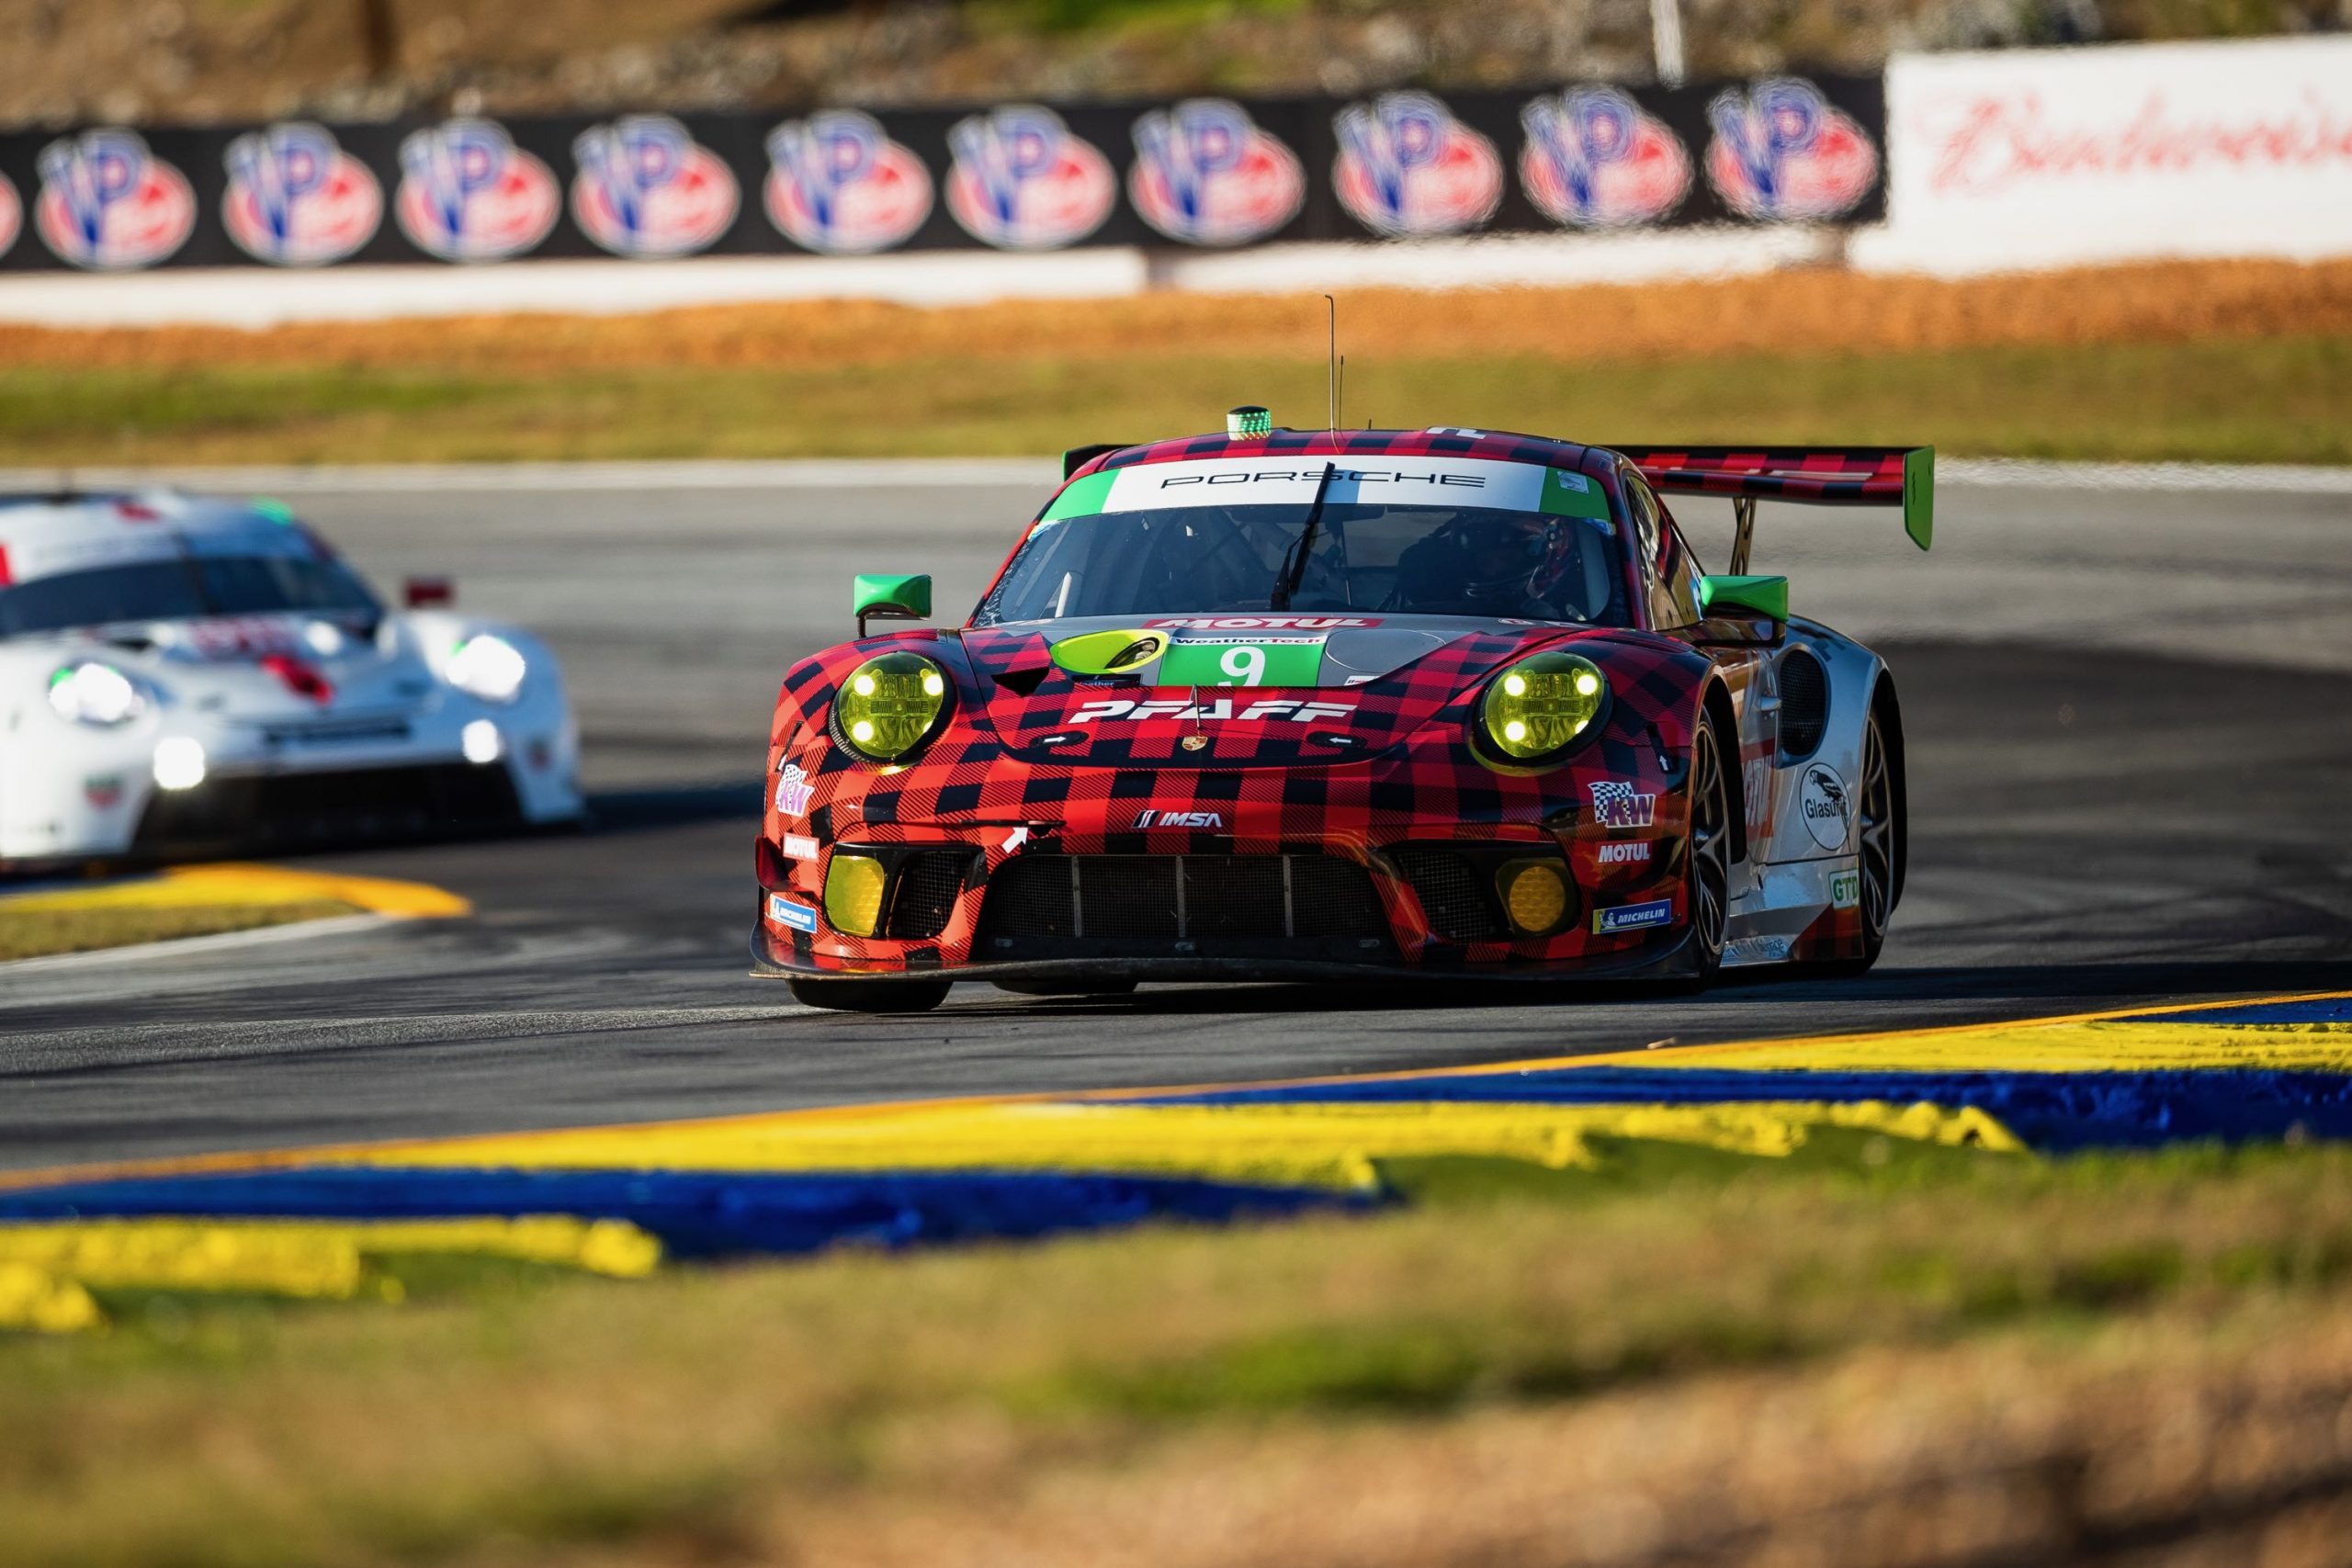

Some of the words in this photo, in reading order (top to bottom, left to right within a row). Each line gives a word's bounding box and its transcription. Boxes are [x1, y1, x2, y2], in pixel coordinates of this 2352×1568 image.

[1160, 470, 1487, 489] PORSCHE
[1152, 618, 1369, 629] MOTUL
[1218, 646, 1266, 686] 9
[1068, 698, 1358, 724] PFAFF
[780, 782, 811, 813] KW
[1159, 812, 1223, 828] IMSA
[1607, 795, 1655, 827] KW
[786, 836, 818, 859] MOTUL
[1598, 842, 1650, 863] MOTUL
[1617, 908, 1666, 924] MICHELIN
